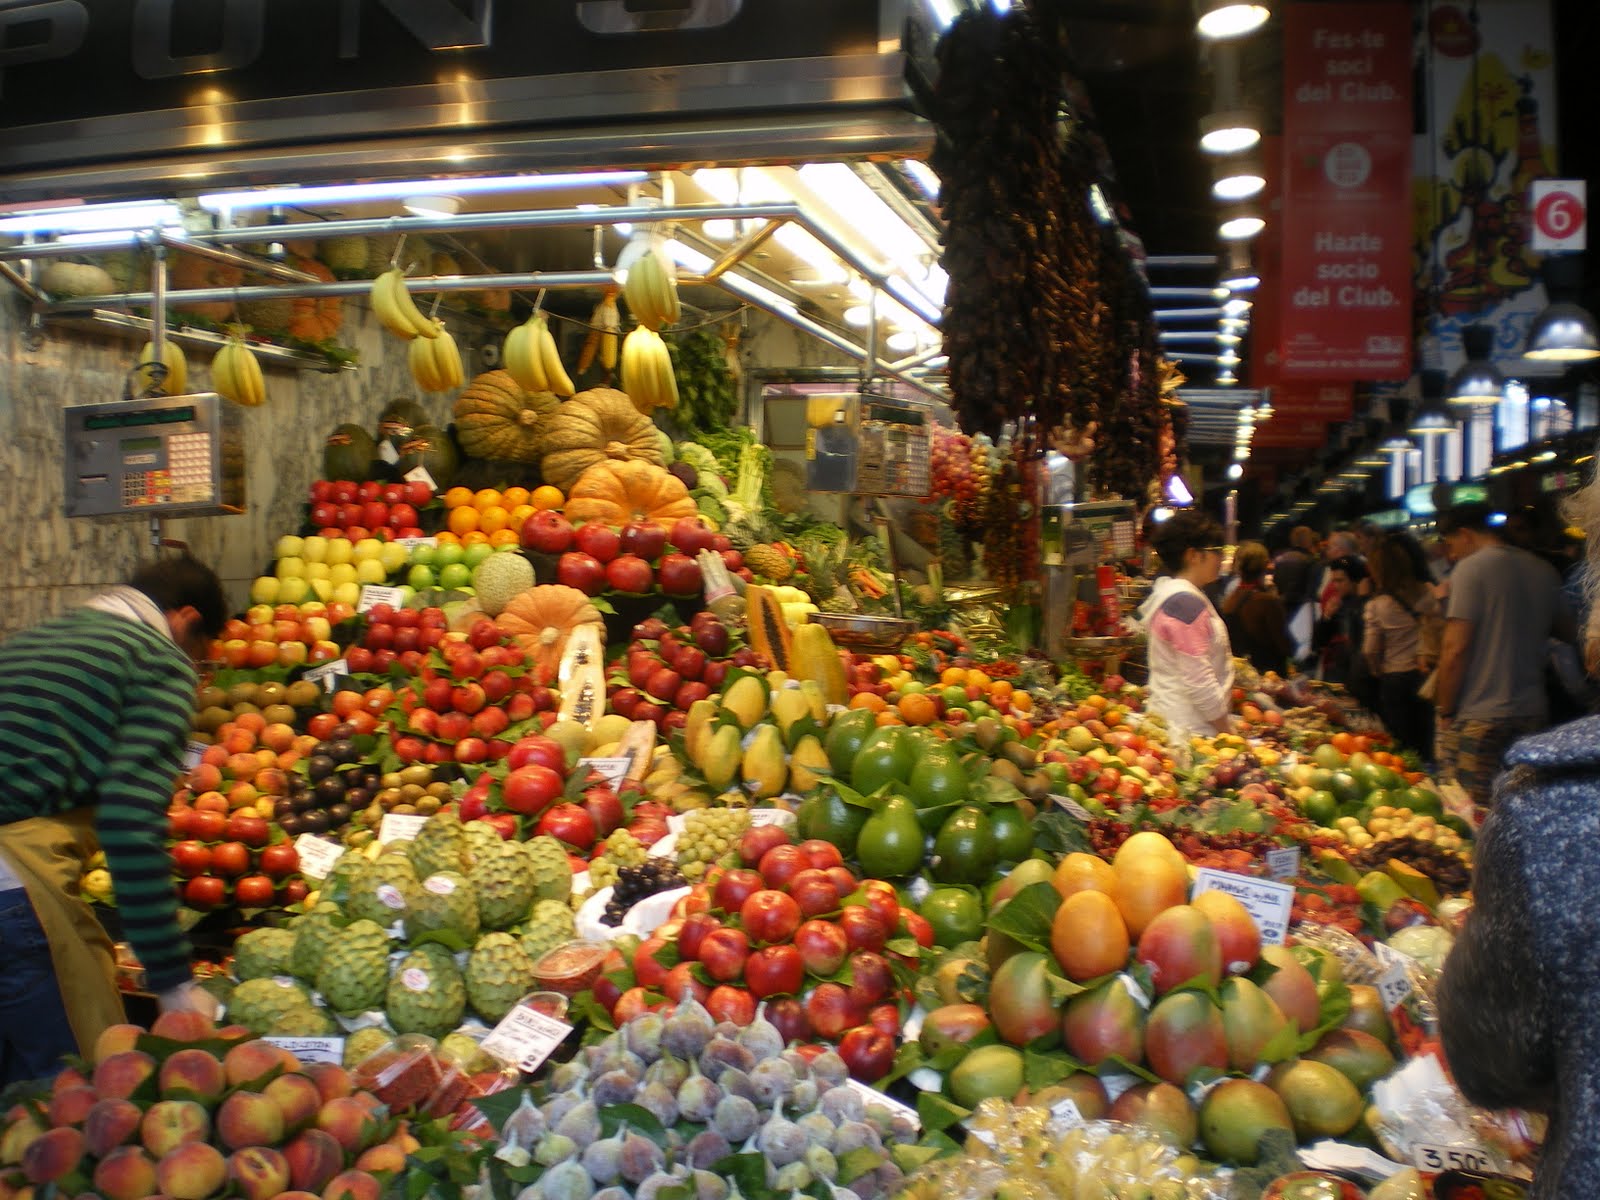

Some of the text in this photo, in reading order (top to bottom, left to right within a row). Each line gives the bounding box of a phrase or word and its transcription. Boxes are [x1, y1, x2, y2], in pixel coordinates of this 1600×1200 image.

[1312, 28, 1385, 49] Fes-te
[1326, 56, 1373, 76] soci
[1296, 81, 1332, 103] del
[1547, 199, 1571, 231] 6
[1315, 231, 1383, 253] Hazte
[1317, 258, 1379, 279] socio
[1293, 286, 1331, 307] del
